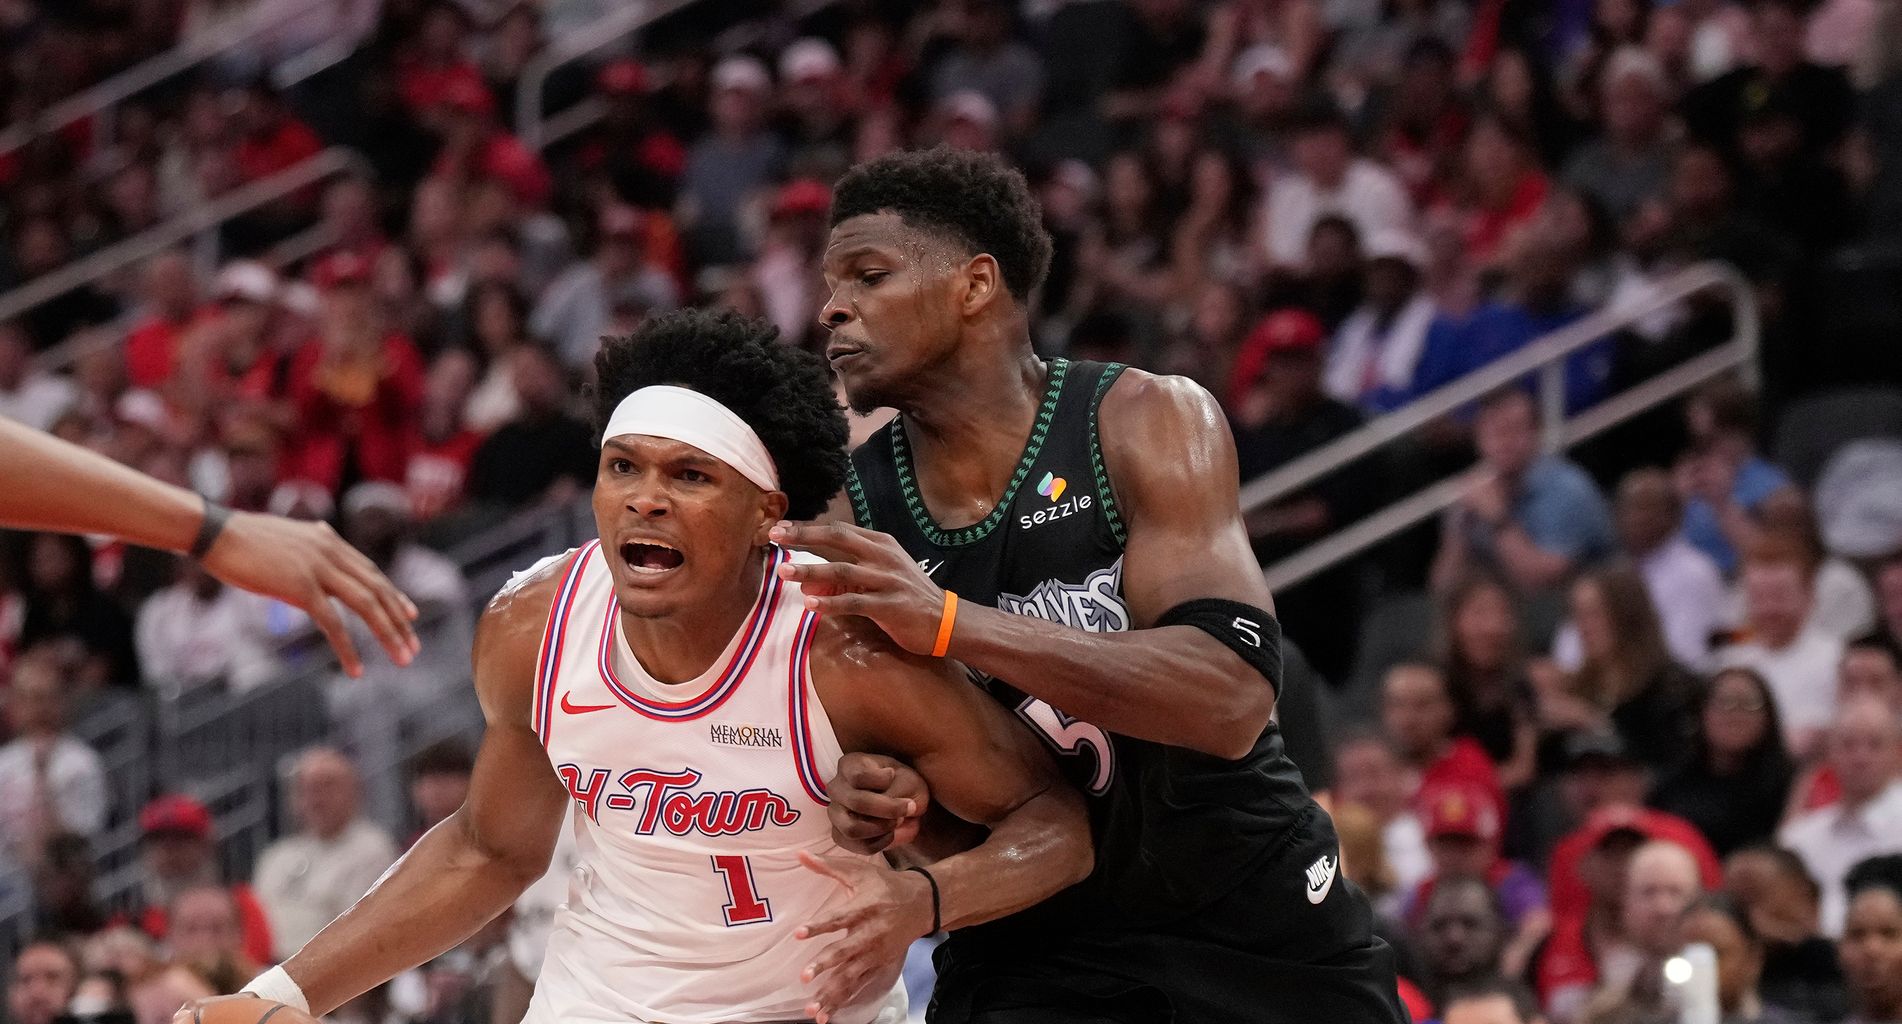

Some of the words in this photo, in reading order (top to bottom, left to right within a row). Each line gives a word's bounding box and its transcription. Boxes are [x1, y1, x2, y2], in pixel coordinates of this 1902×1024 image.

[1020, 494, 1092, 530] sezzle
[1231, 616, 1262, 648] 5
[710, 724, 782, 739] MEMORIAL
[711, 733, 783, 747] HERMANN
[1015, 696, 1116, 798] 5
[558, 763, 801, 837] H-Town
[1305, 855, 1331, 890] NIKE
[710, 855, 772, 928] 1
